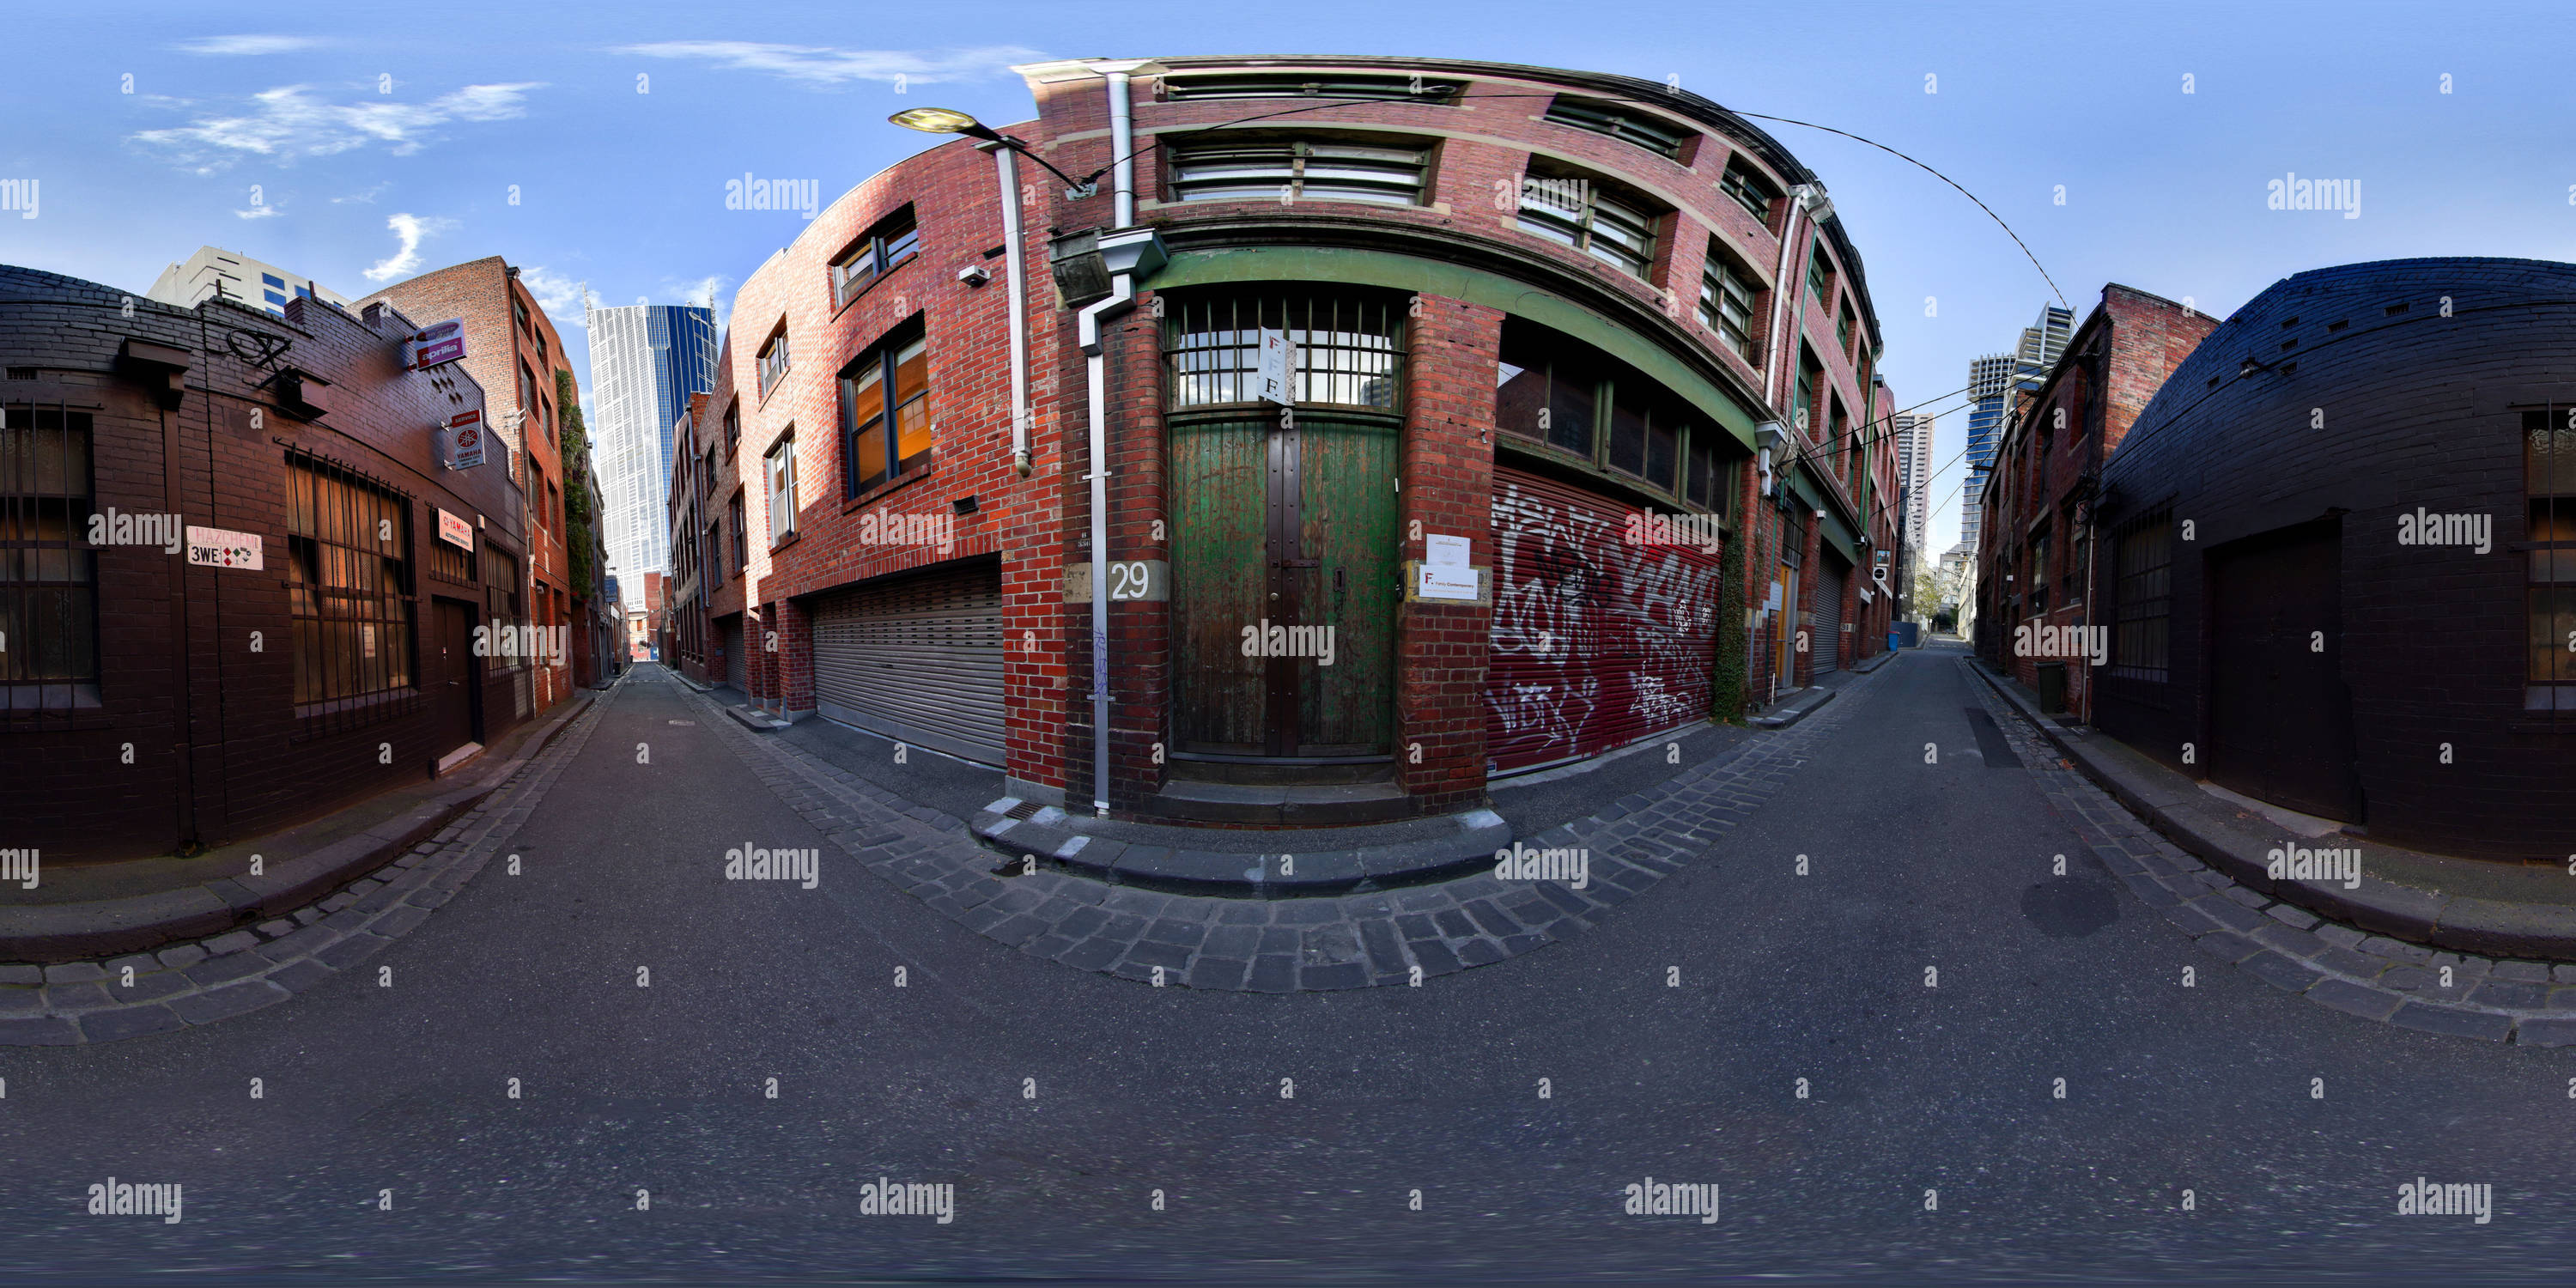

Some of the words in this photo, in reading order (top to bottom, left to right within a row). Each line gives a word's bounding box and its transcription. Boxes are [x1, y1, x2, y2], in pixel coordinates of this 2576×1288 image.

[422, 344, 458, 361] aprilia
[457, 448, 482, 459] YAMAHA
[449, 517, 471, 538] YAMAHA
[196, 528, 255, 549] HAZCHEM
[191, 546, 219, 563] 3WE
[1111, 562, 1149, 599] 29
